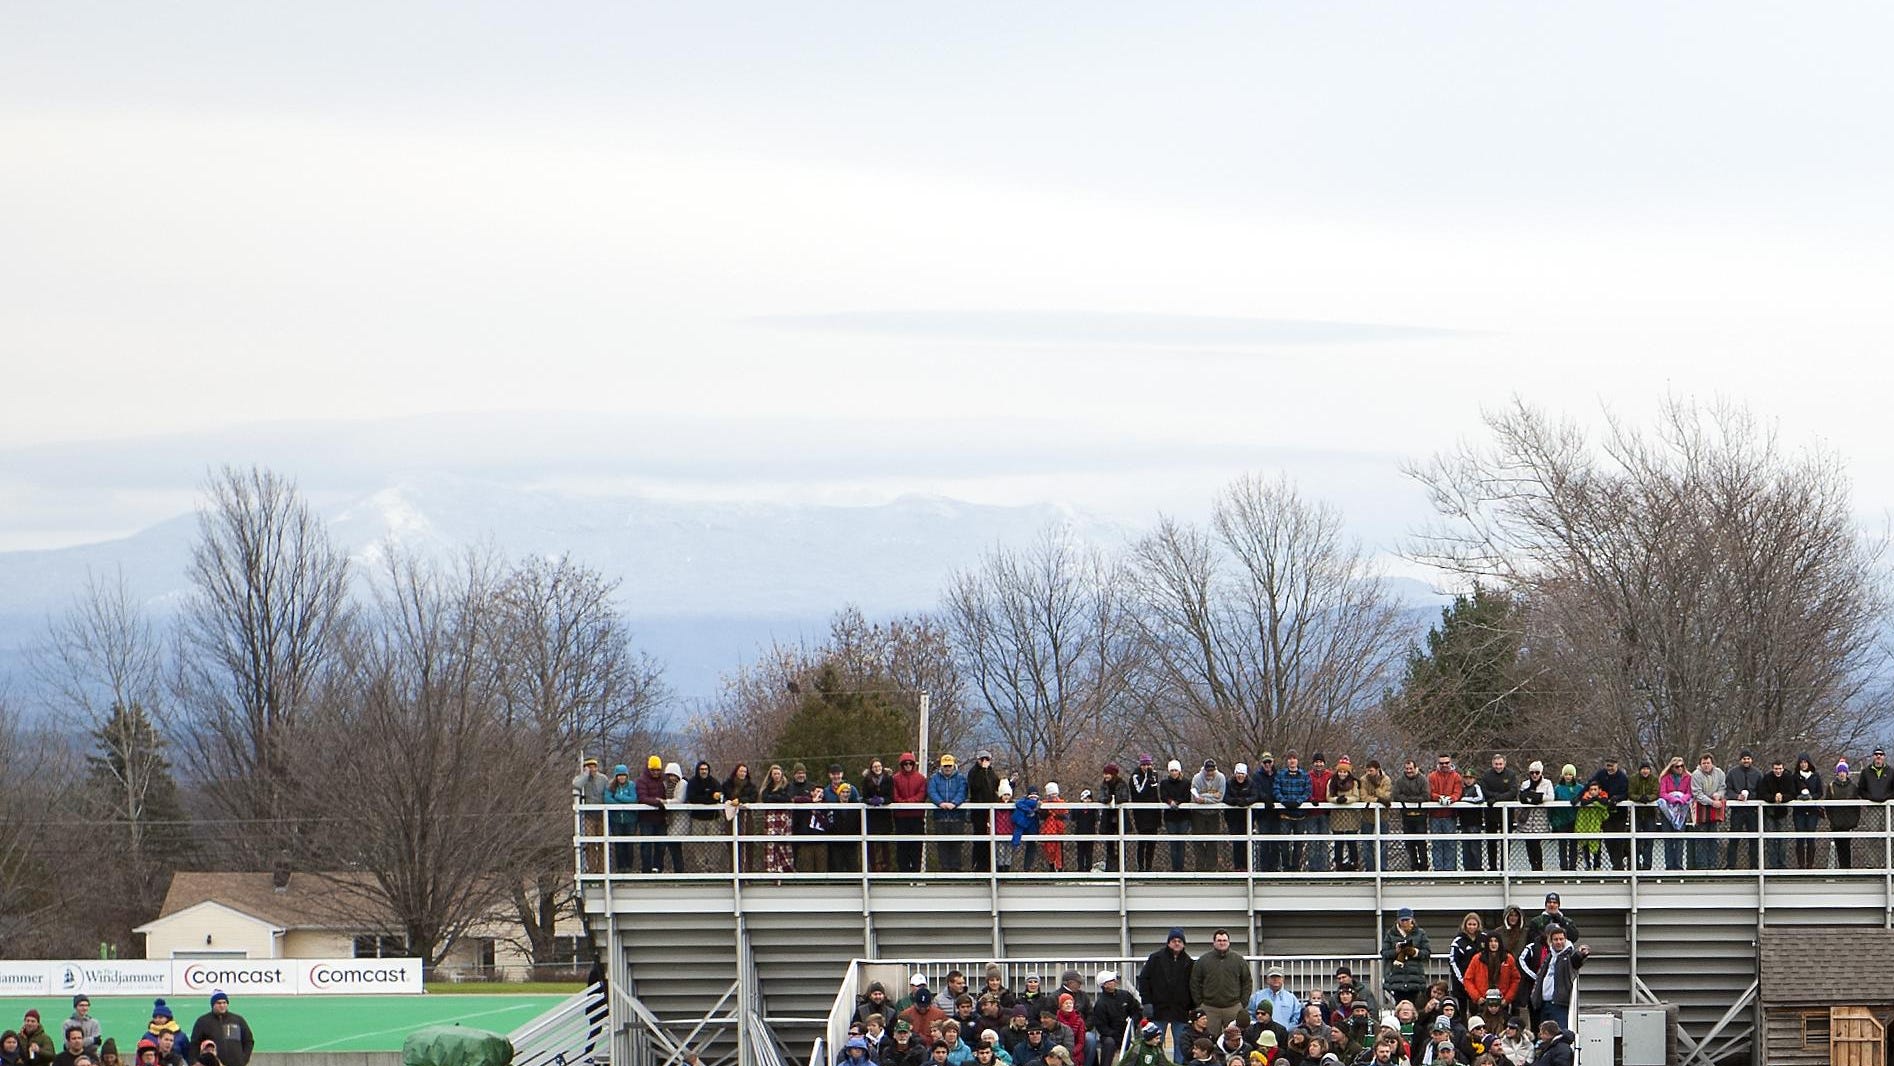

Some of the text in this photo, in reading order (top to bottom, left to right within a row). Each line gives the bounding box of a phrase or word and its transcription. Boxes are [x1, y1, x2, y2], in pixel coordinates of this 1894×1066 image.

[0, 973, 43, 984] ammer
[85, 970, 164, 985] Windjammer
[192, 967, 283, 984] comcast
[317, 966, 407, 983] comcast
